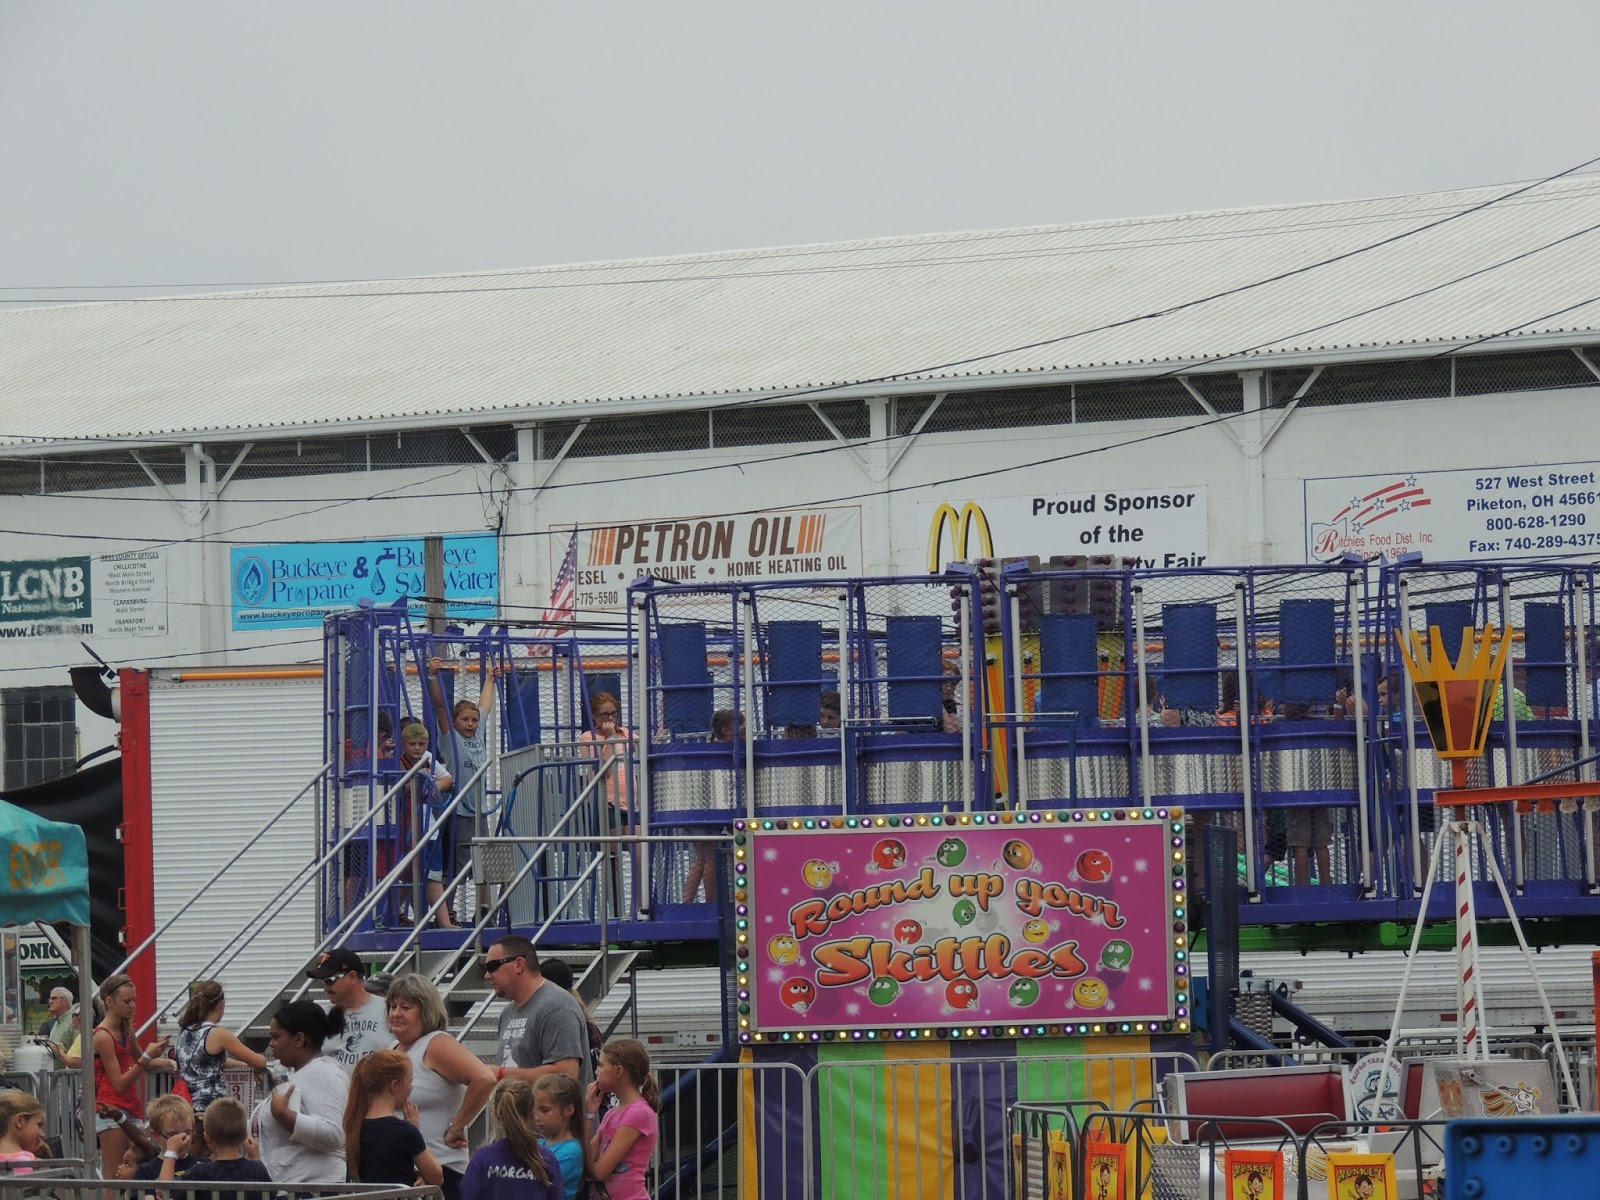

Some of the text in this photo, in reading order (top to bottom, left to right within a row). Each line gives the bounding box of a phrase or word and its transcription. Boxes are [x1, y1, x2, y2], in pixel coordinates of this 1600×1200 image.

[1475, 472, 1595, 490] 527 West Street
[1032, 493, 1195, 516] Proud Sponsor
[1467, 498, 1527, 511] Piketon,
[1531, 494, 1554, 508] OH
[1486, 513, 1586, 531] 800-628-1290
[614, 516, 795, 565] PETRON OIL
[1079, 524, 1144, 544] of the
[1314, 529, 1435, 554] Ritchies Food Dist. Inc.
[1469, 540, 1500, 552] Fax:
[352, 556, 369, 578] &
[397, 547, 477, 568] Bueye
[272, 558, 347, 580] Buckeye
[578, 570, 607, 585] ESEL
[727, 560, 762, 577] HOME
[768, 557, 822, 574] HEATING
[827, 555, 847, 571] OIL
[0, 566, 85, 601] LCNB
[791, 868, 1125, 939] Round up your
[813, 933, 1087, 986] Skittles
[1233, 1163, 1274, 1180] MONKEY
[1337, 1167, 1383, 1183] MONKEY
